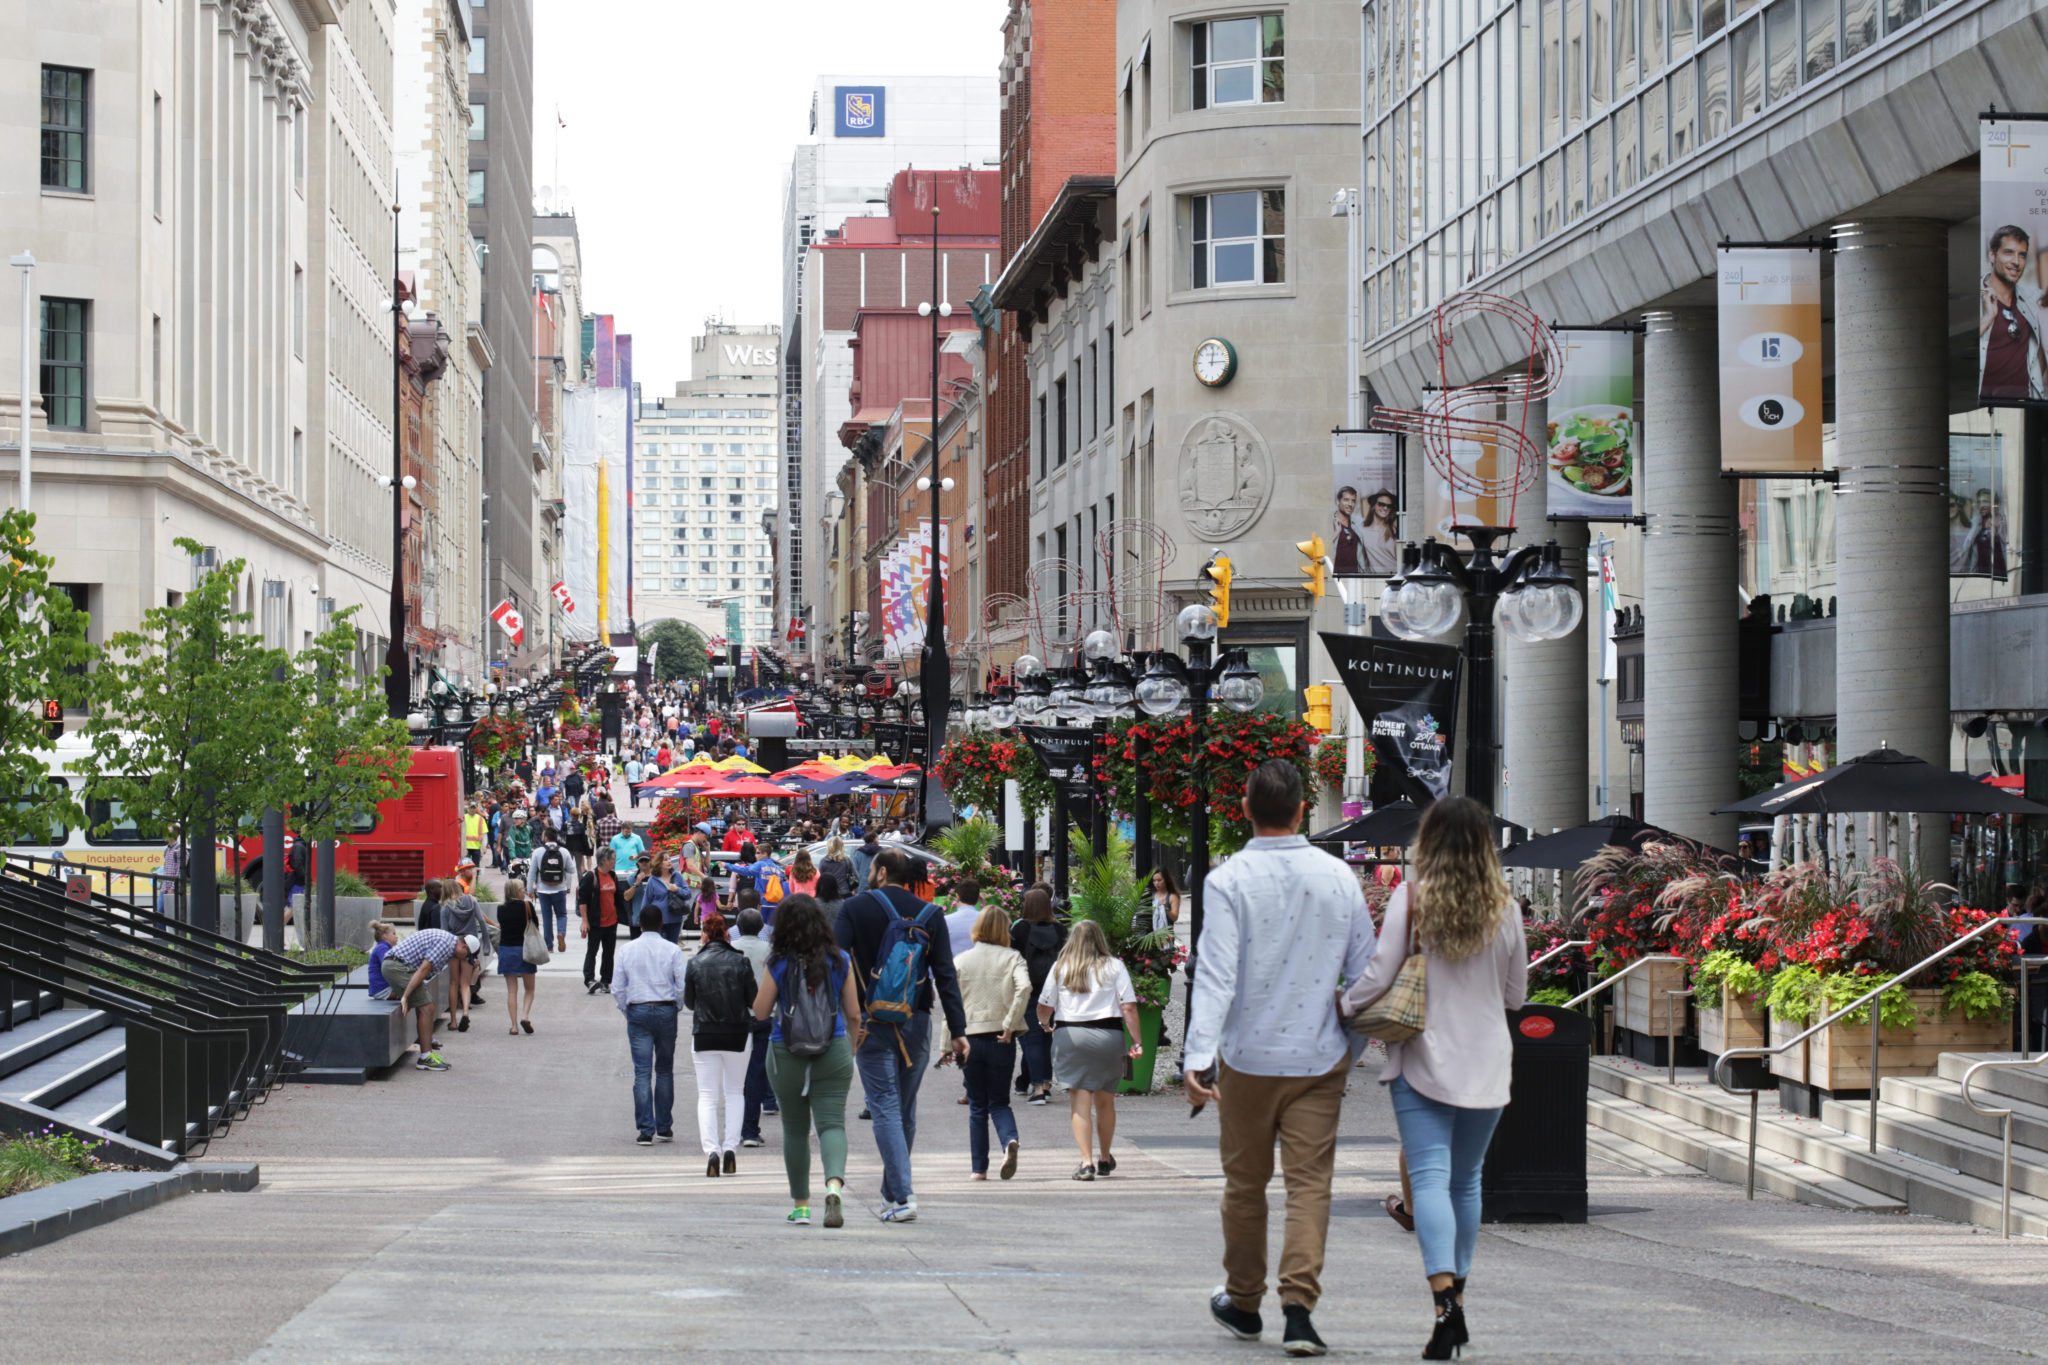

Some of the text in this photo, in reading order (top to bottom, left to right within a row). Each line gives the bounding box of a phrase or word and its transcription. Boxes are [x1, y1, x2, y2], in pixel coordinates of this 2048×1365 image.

[850, 117, 870, 125] RBC
[1988, 131, 2006, 142] 240
[1348, 659, 1453, 681] KONTINUUM
[1372, 720, 1407, 730] MOMENT
[1372, 728, 1406, 737] FACTORY
[1415, 731, 1437, 743] 2017
[1034, 737, 1091, 746] KONTINUUM
[1409, 741, 1441, 752] OTTAWA
[86, 854, 161, 864] Incubateur de
